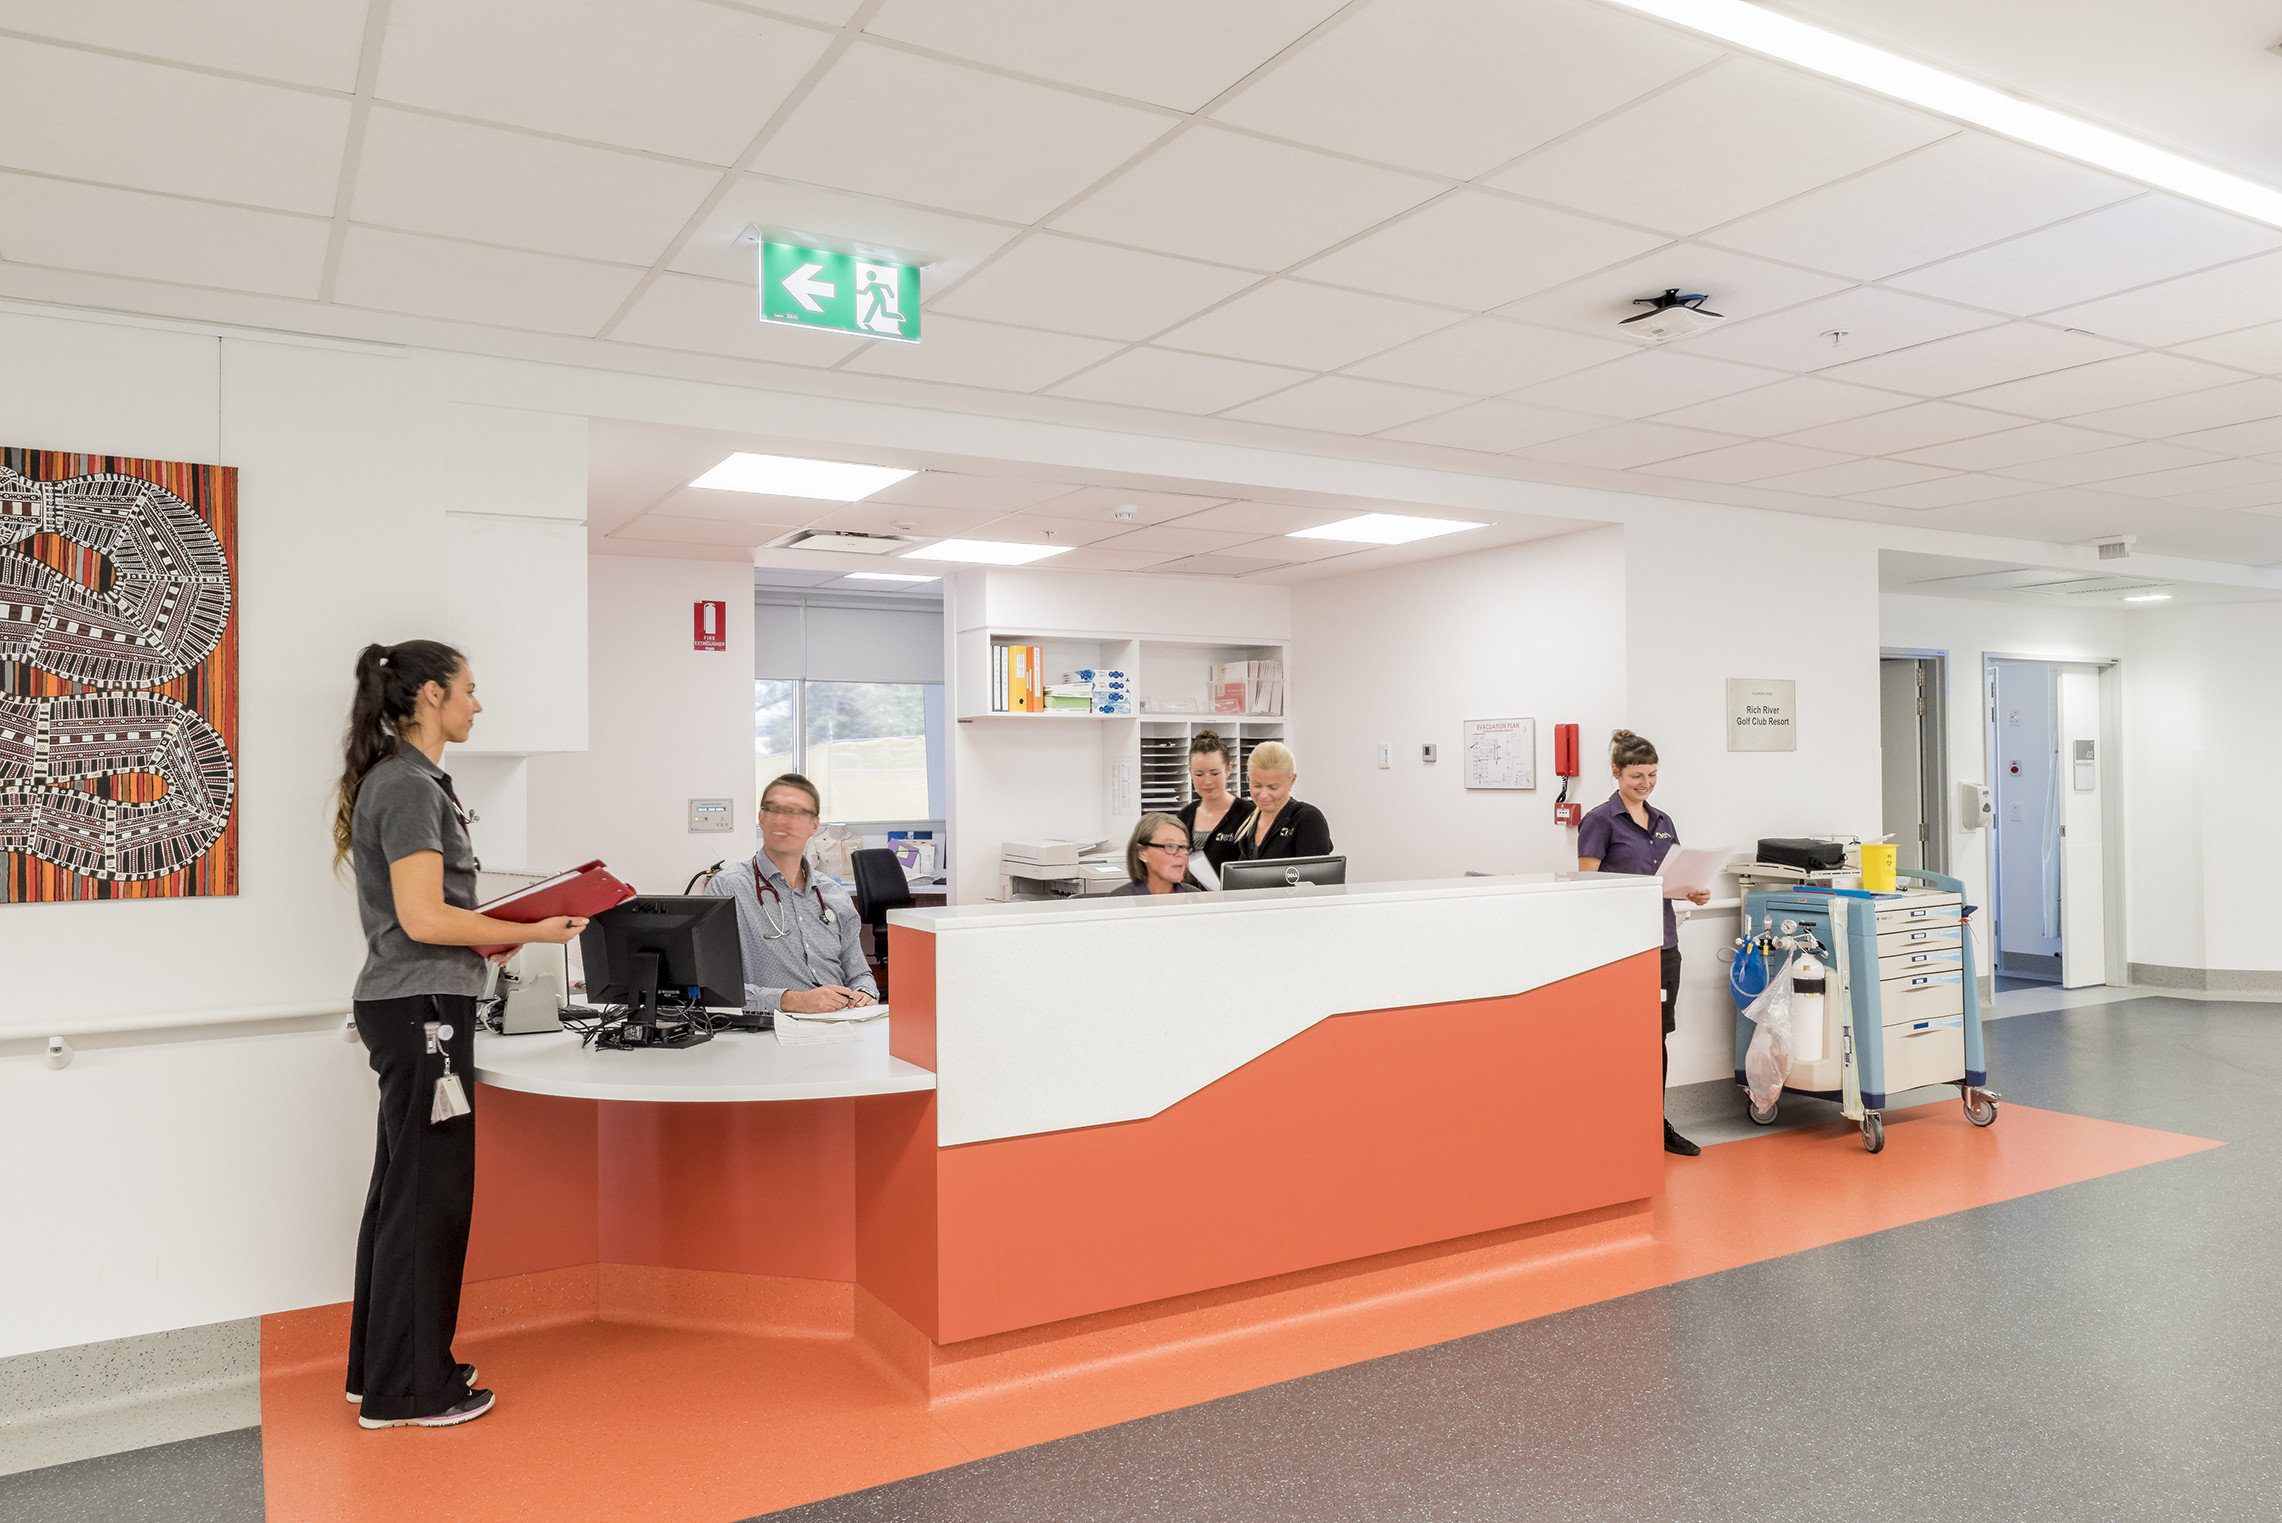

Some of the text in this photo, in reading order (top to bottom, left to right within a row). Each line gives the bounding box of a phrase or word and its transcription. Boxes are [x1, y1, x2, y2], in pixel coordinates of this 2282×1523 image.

[1746, 705, 1780, 714] Rich River
[1736, 717, 1790, 726] Golf Club Resort
[1476, 723, 1507, 731] EVACUATION
